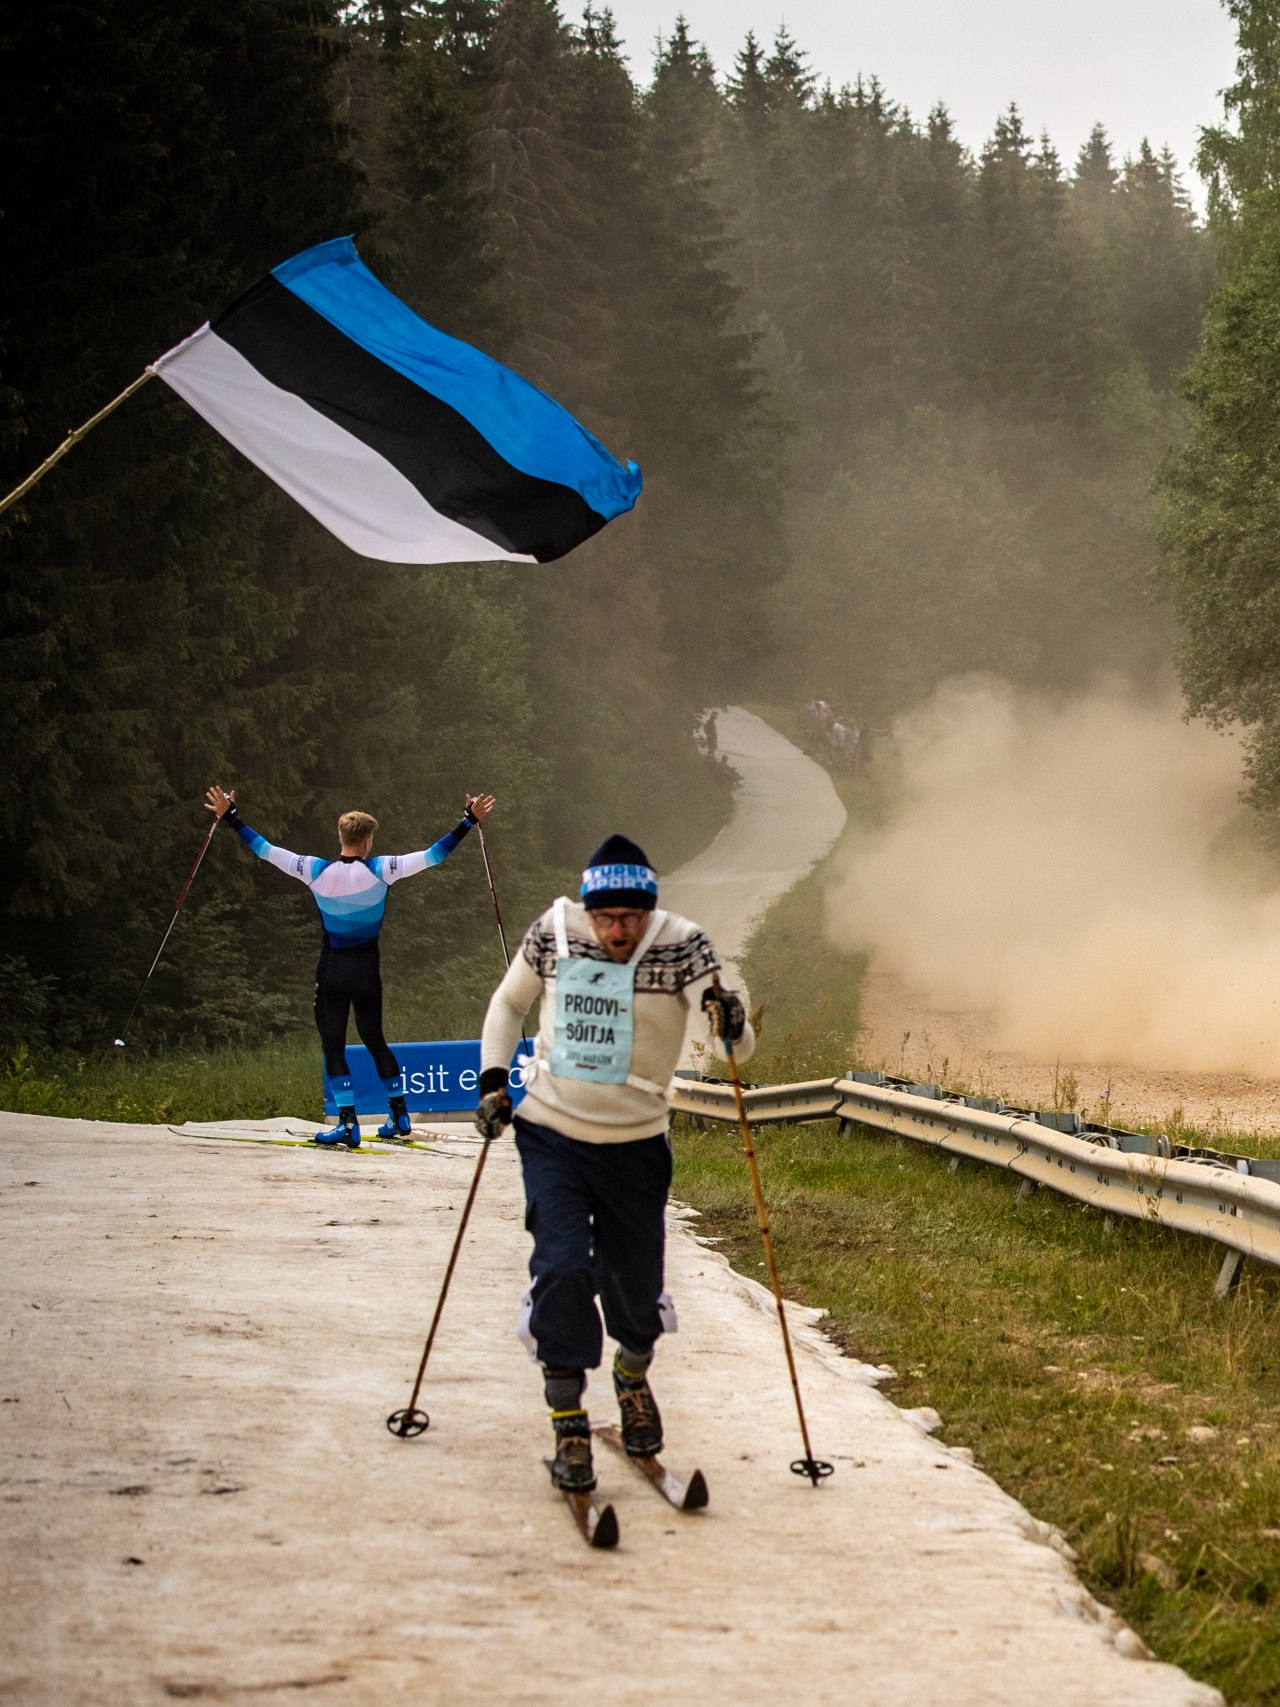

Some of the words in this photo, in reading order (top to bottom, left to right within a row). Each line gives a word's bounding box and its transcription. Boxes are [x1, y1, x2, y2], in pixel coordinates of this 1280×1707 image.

[564, 993, 628, 1017] PROOVI-
[566, 1019, 616, 1046] SÕITJA
[400, 1064, 450, 1095] isit
